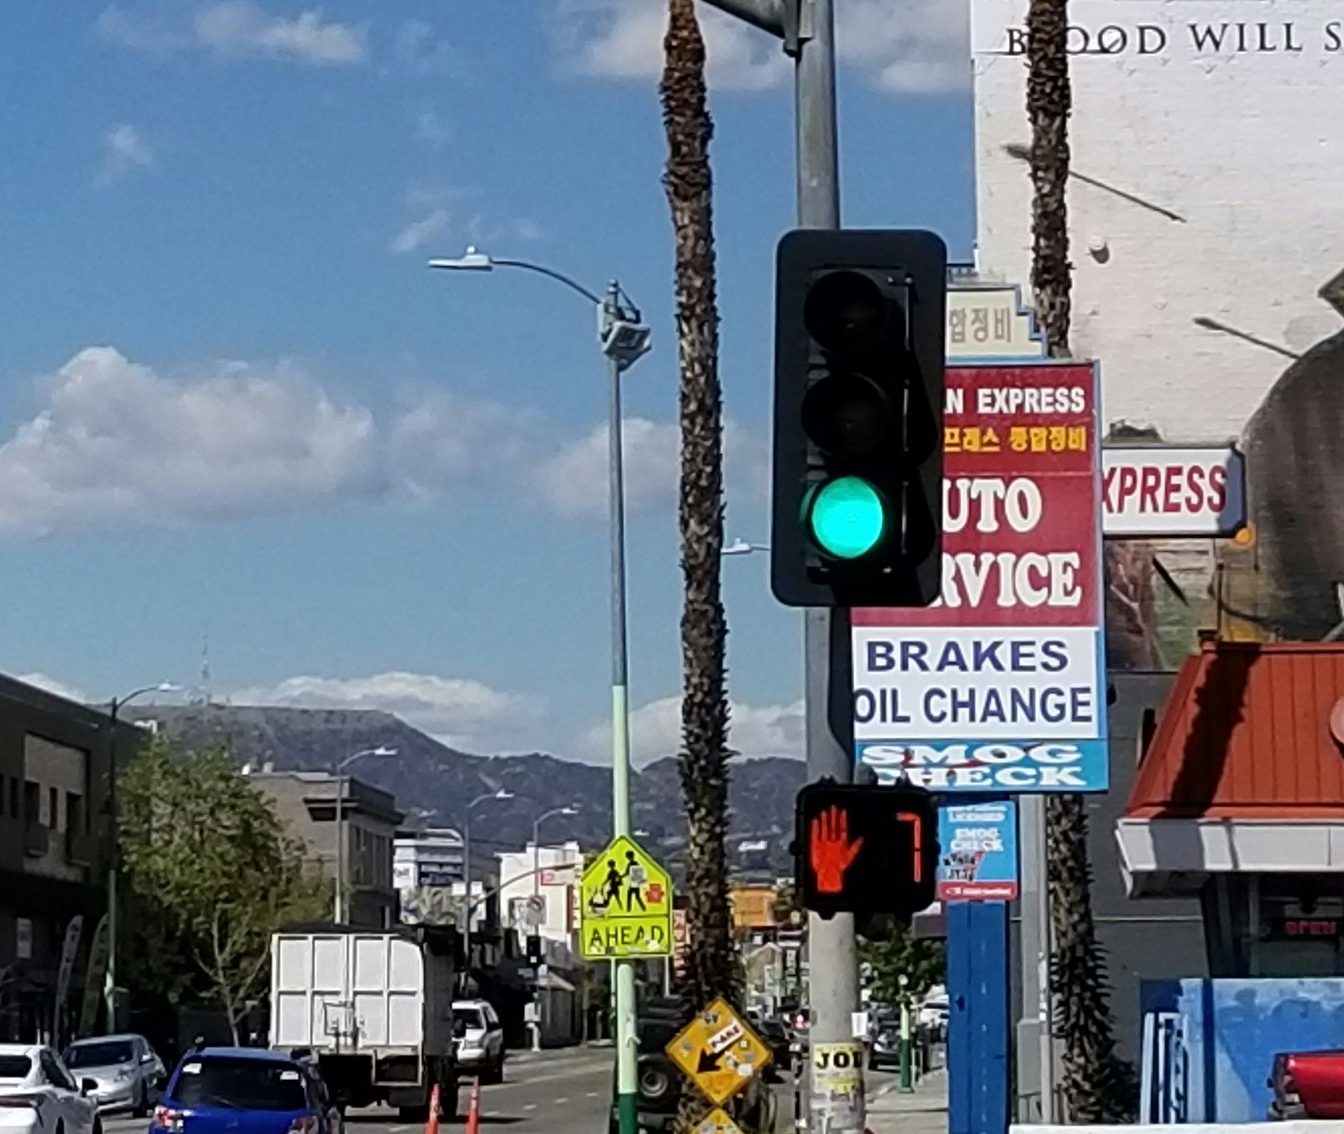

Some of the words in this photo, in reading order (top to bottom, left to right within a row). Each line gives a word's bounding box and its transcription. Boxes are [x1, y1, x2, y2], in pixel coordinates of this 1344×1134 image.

[1006, 24, 1166, 56] BOOD
[1188, 21, 1304, 53] WILL
[944, 387, 965, 414] N
[977, 386, 1086, 414] EXPRESS
[931, 551, 1083, 608] RVICE
[866, 640, 1070, 673] BRAKES
[853, 688, 911, 724] OIL
[922, 686, 1094, 725] CHANGE
[861, 744, 1083, 766] SMOG
[589, 925, 665, 947] AHEAD
